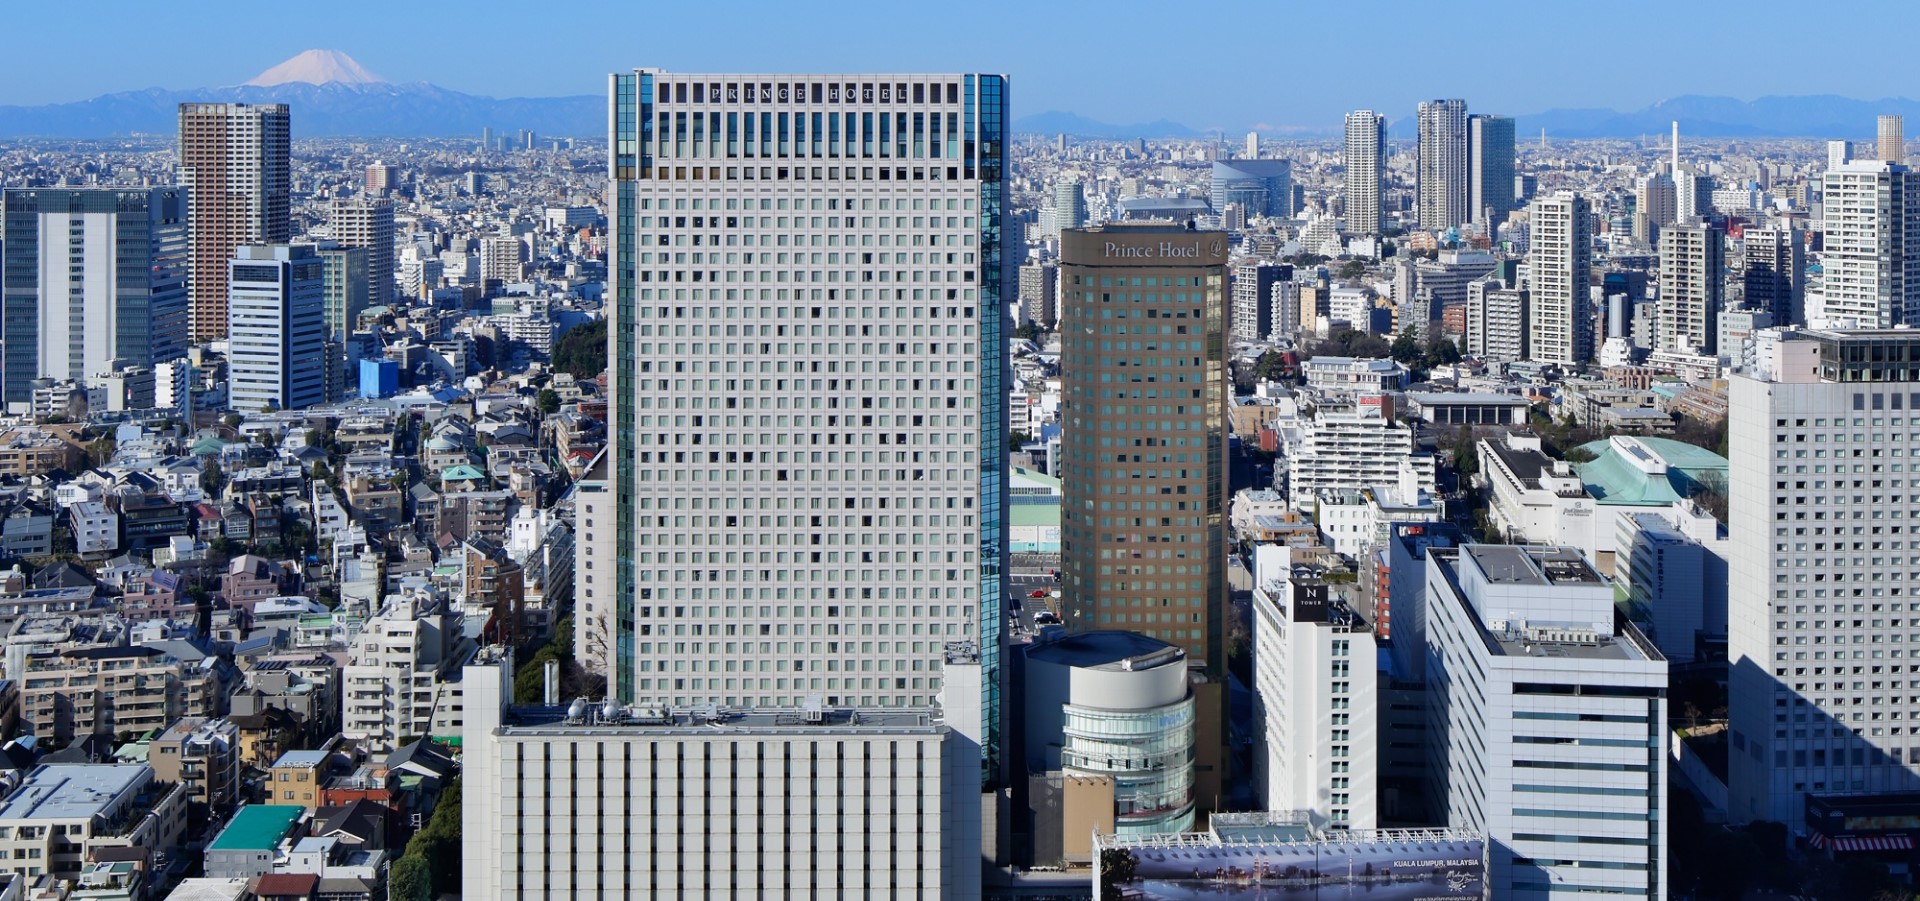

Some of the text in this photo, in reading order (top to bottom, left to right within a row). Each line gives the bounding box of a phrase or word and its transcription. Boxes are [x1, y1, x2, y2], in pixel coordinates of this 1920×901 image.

[711, 88, 907, 99] PRINCE HOTEL
[1105, 241, 1199, 258] Prince Hotel
[1306, 587, 1317, 598] N
[1393, 860, 1416, 868] KUALA
[1446, 859, 1479, 867] MALAYSIA
